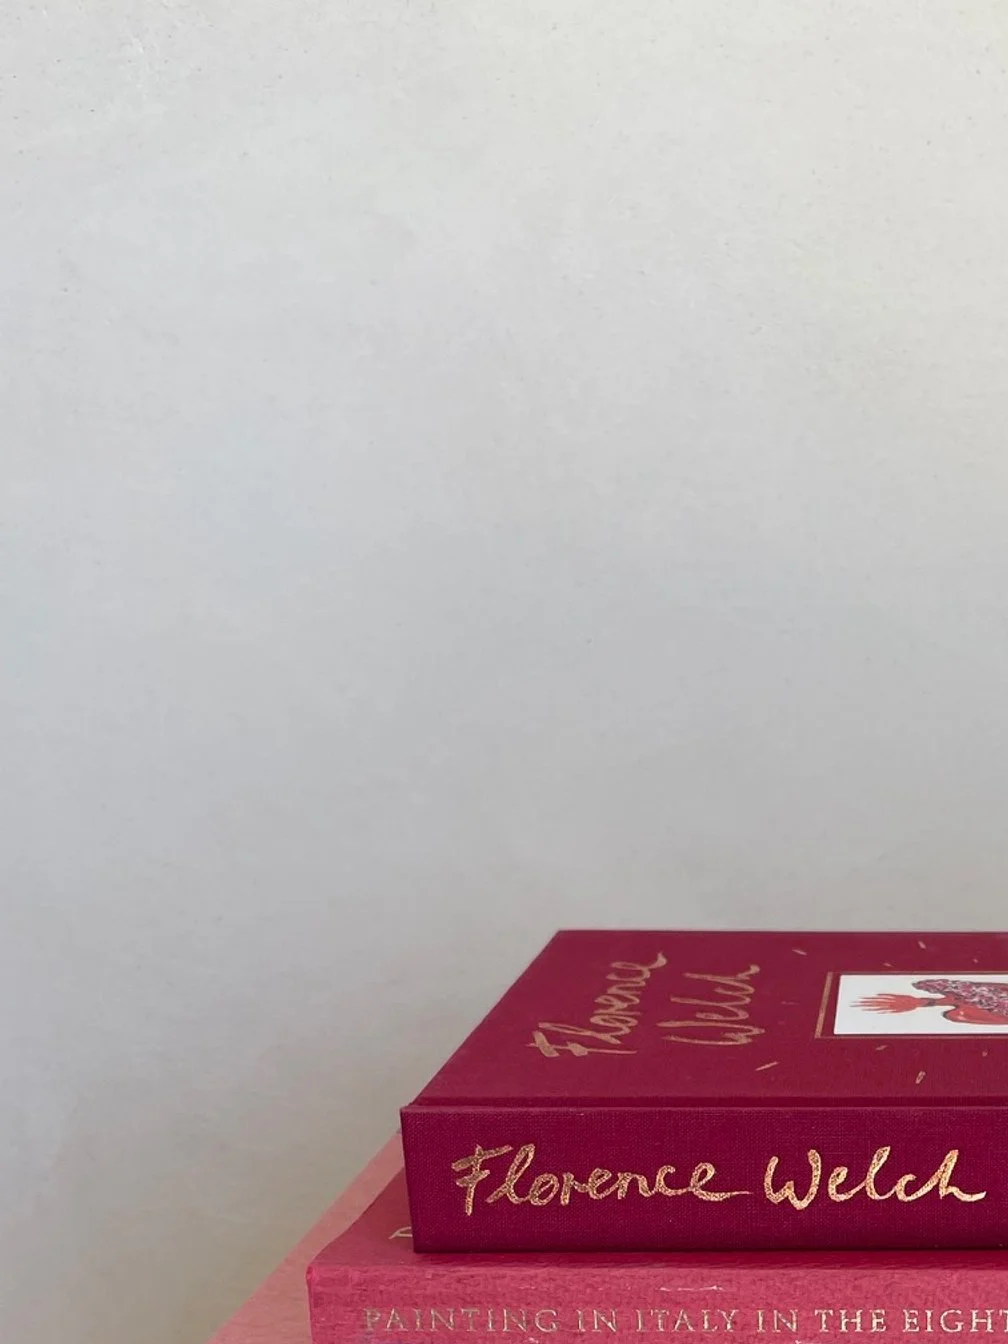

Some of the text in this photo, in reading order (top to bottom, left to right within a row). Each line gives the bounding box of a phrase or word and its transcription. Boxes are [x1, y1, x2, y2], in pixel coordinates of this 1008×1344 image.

[525, 952, 668, 1058] Florence
[657, 964, 766, 1045] Welch
[452, 1143, 751, 1216] Florence
[764, 1146, 986, 1210] Welch
[361, 1307, 560, 1333] PAINTING
[576, 1308, 618, 1333] IN
[635, 1308, 736, 1333] ITALY
[756, 1308, 798, 1333] IN
[814, 1308, 887, 1333] THE
